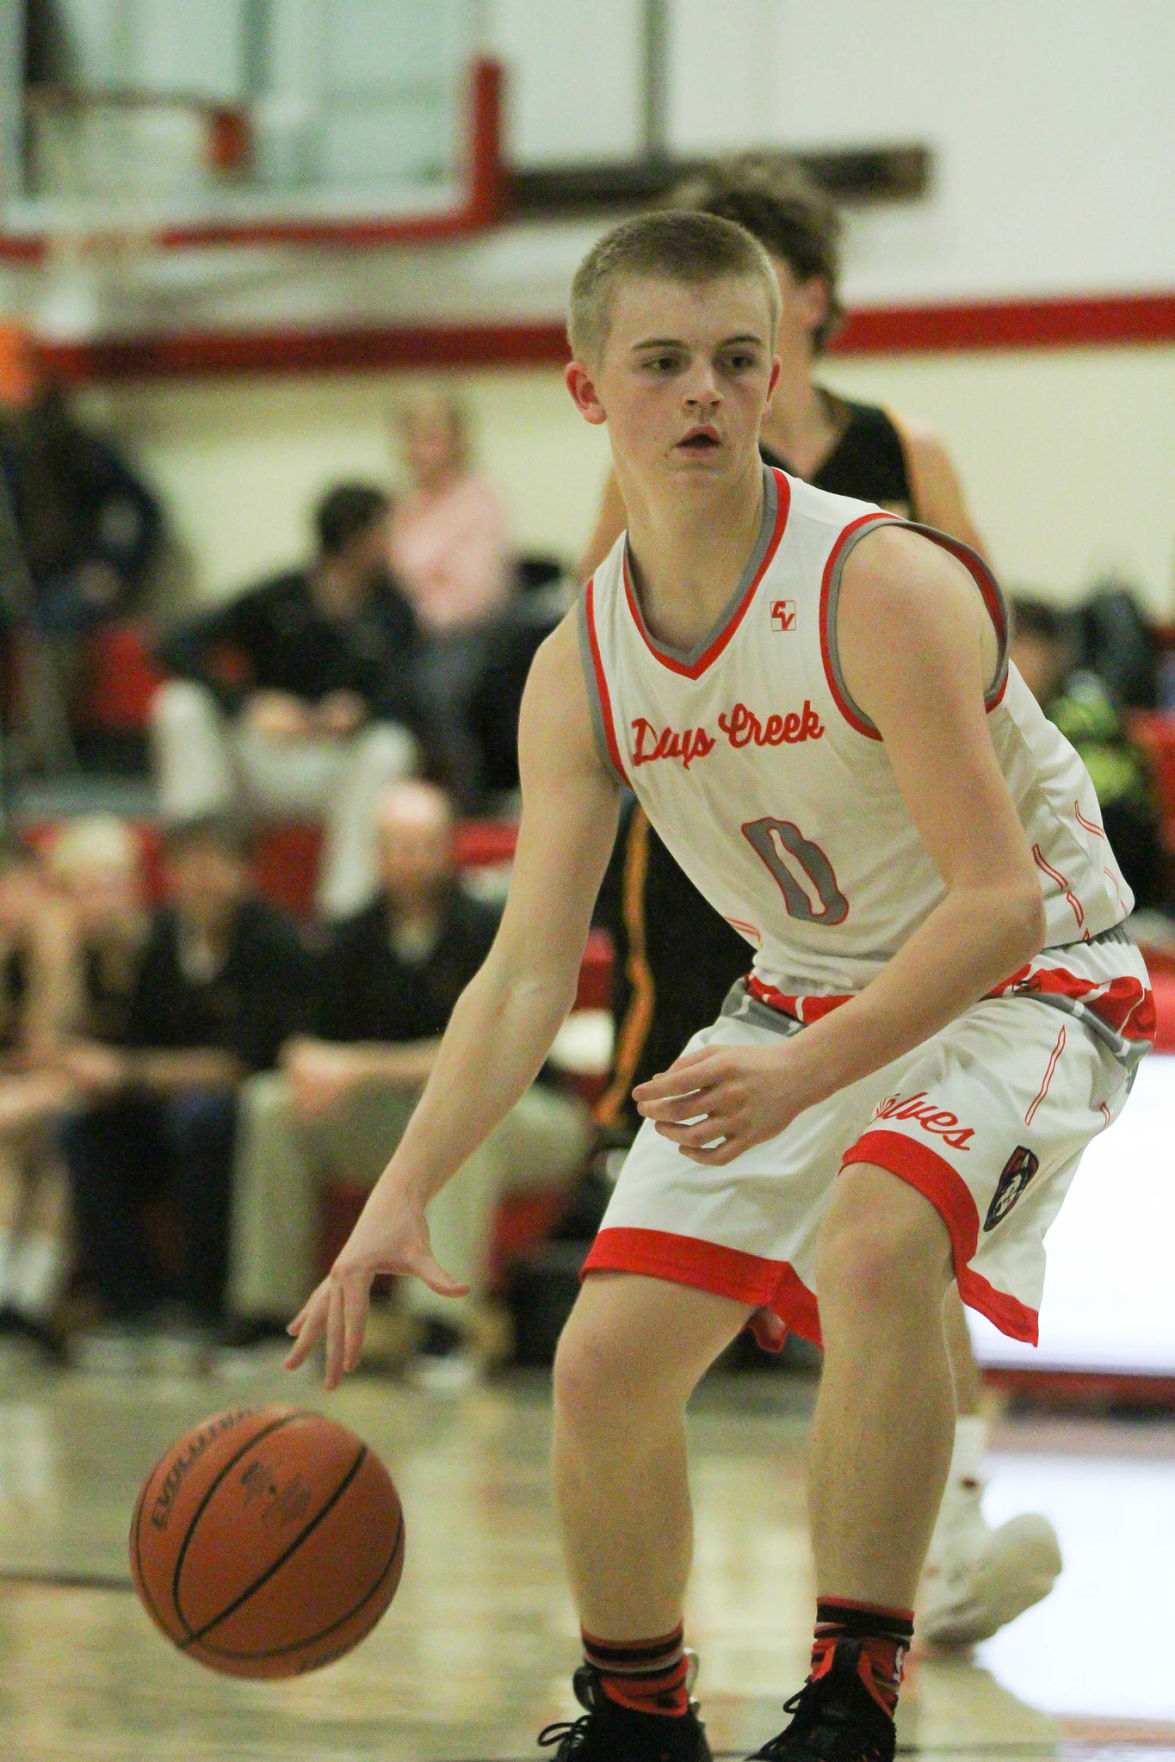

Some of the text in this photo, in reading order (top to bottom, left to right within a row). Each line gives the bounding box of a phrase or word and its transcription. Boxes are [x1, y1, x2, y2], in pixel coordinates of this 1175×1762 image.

[631, 699, 825, 771] Days Creek
[741, 816, 849, 926] 0
[875, 1091, 976, 1151] lves
